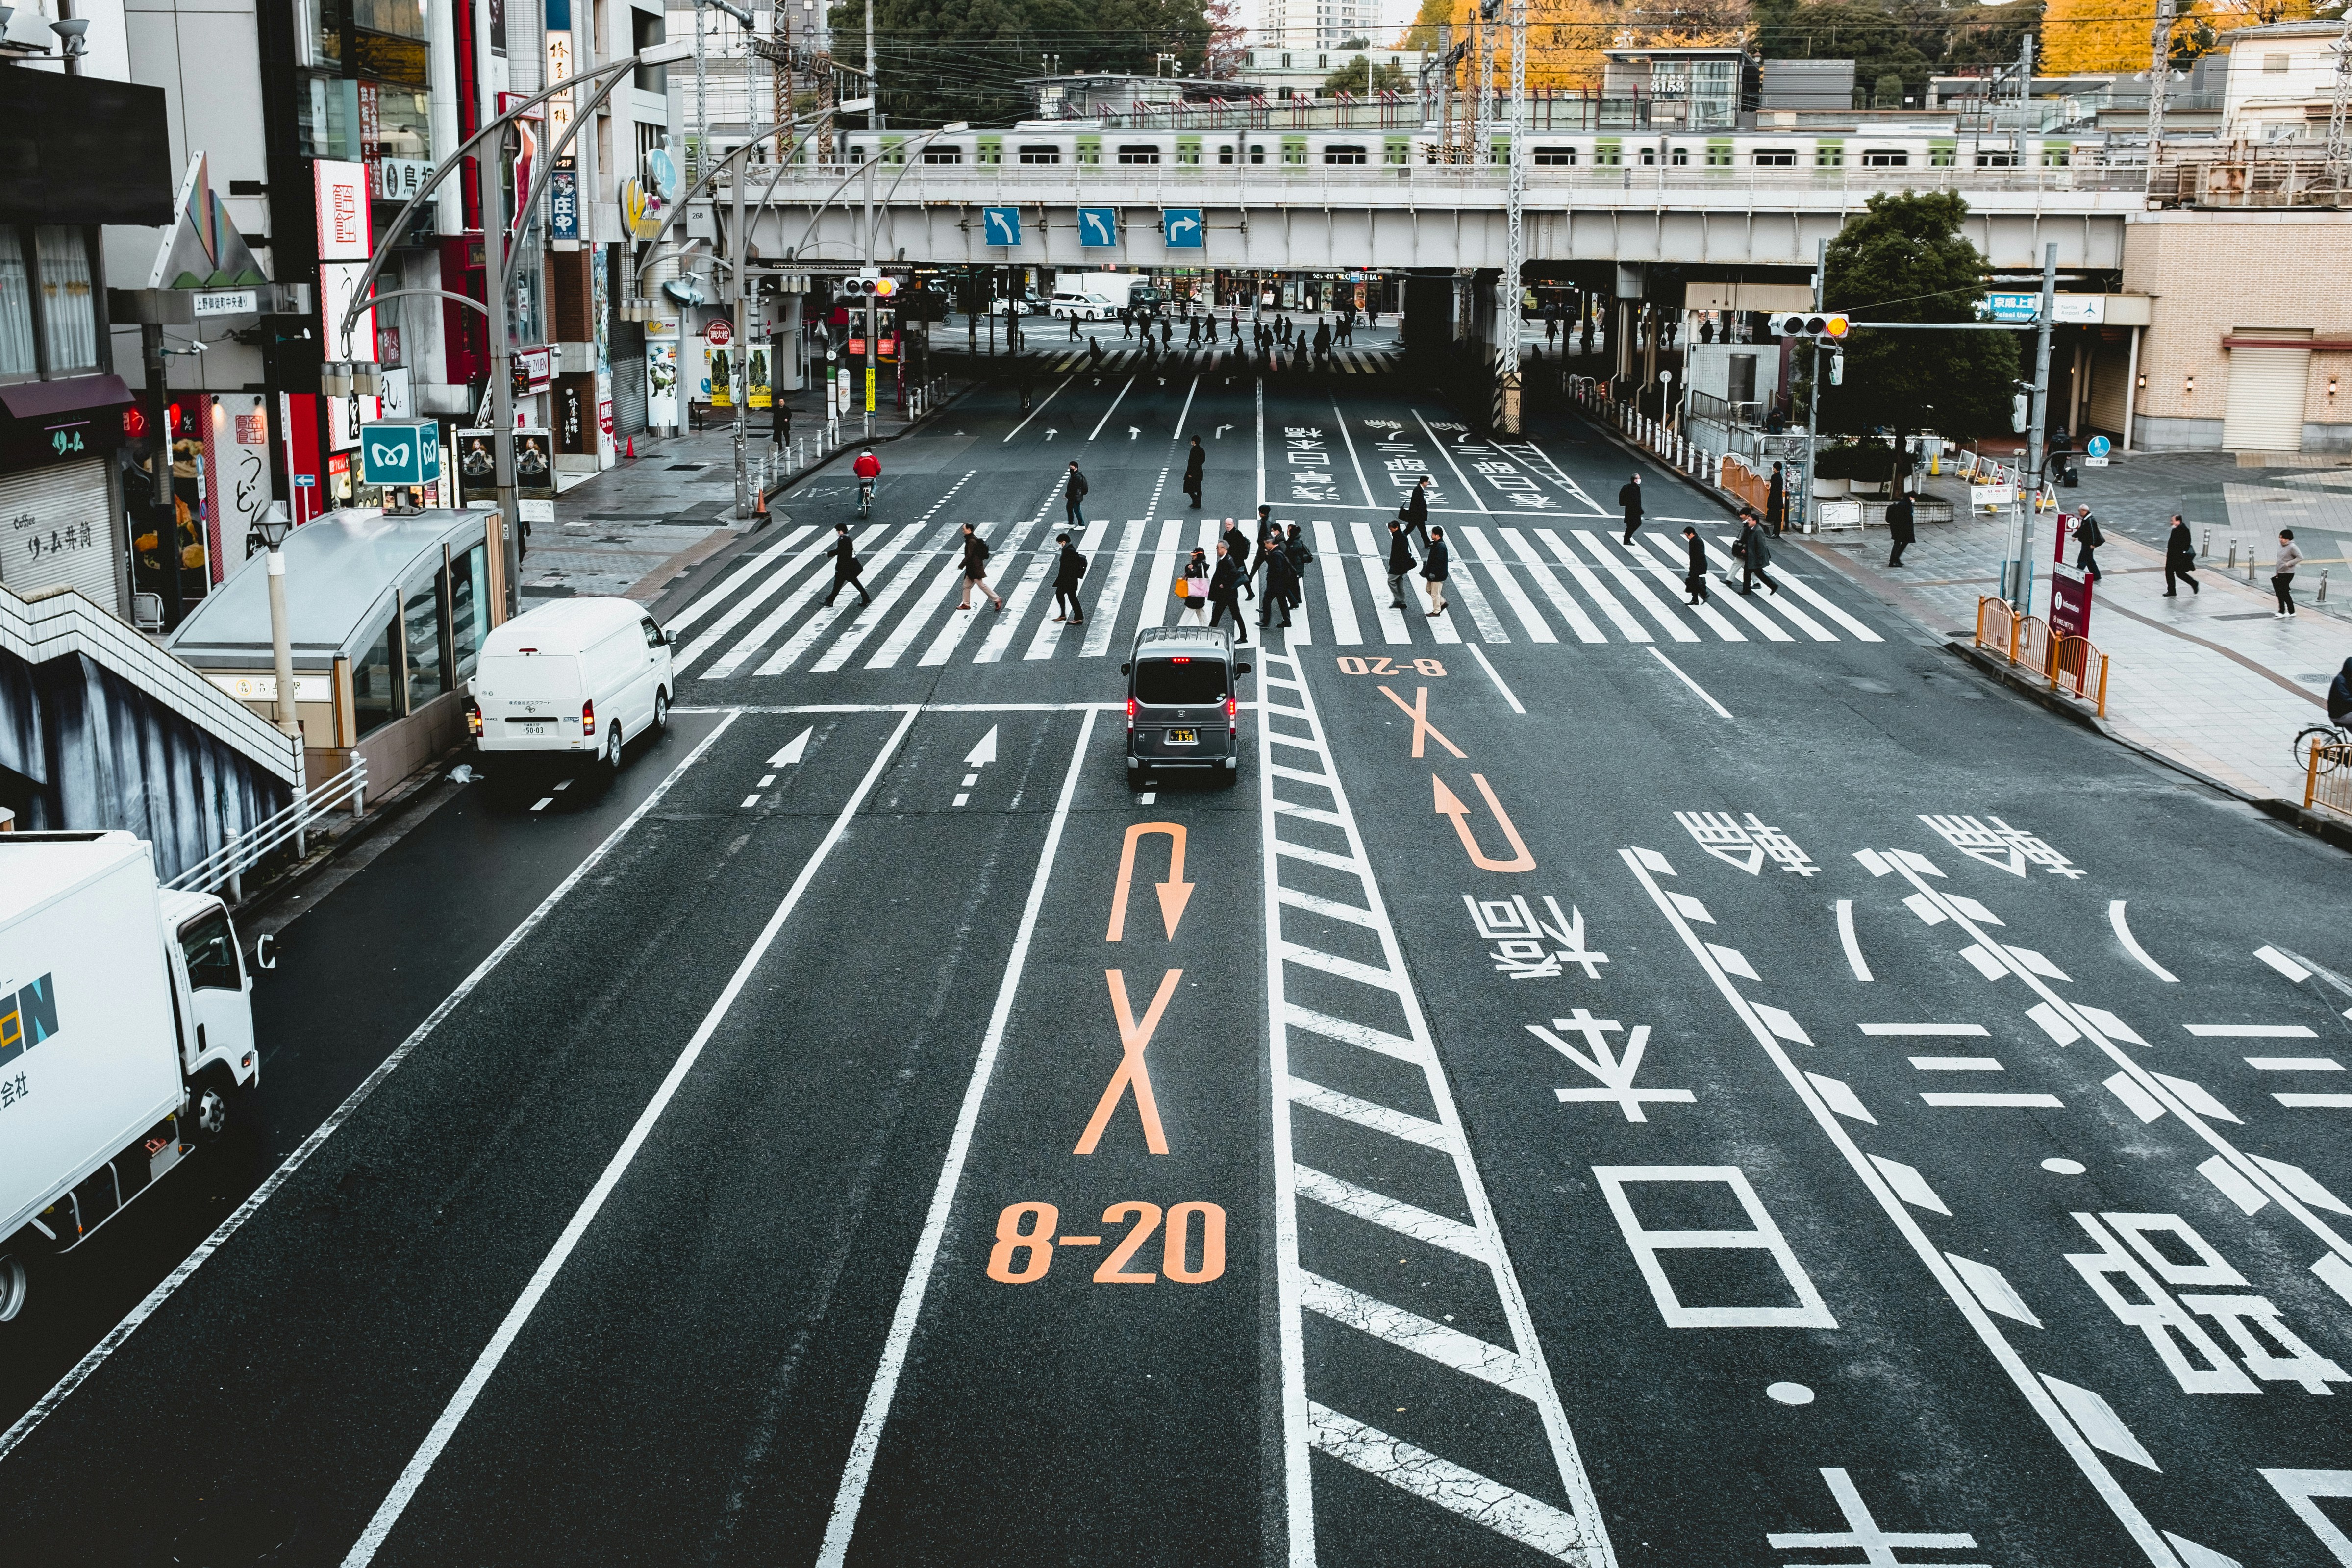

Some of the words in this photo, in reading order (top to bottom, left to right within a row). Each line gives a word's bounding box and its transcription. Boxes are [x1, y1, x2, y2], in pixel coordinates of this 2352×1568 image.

[1651, 80, 1685, 93] 3153
[554, 197, 573, 231] 庄や
[710, 330, 729, 339] 消火栓
[13, 514, 36, 530] Coffee
[986, 1202, 1226, 1283] 8-20
